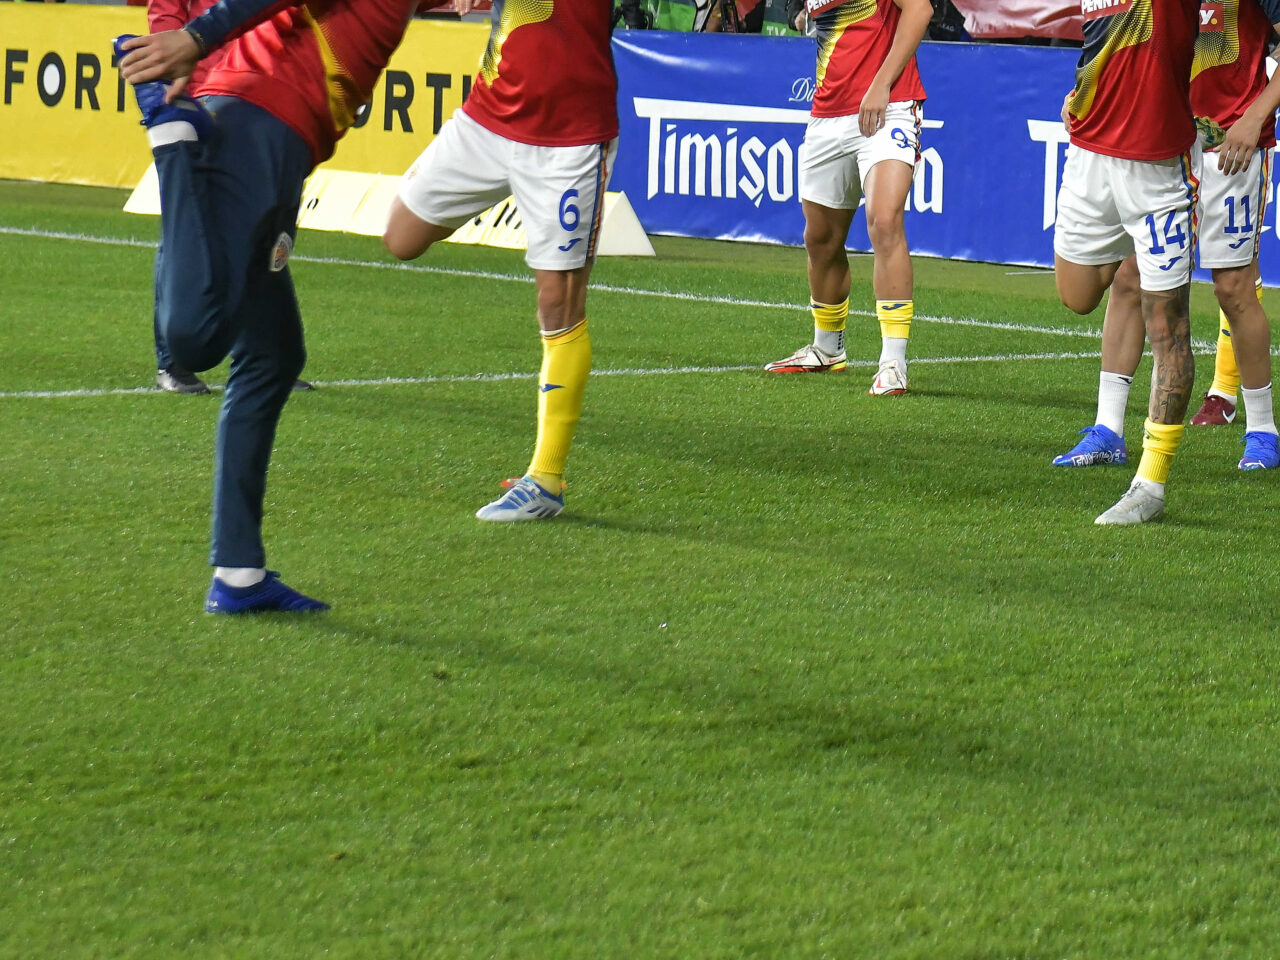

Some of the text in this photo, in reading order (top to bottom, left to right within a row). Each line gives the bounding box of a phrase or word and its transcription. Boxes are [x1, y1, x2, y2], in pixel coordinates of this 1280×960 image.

[891, 128, 912, 148] 9
[559, 189, 580, 231] 6
[1224, 195, 1253, 233] 11
[1145, 211, 1185, 254] 14
